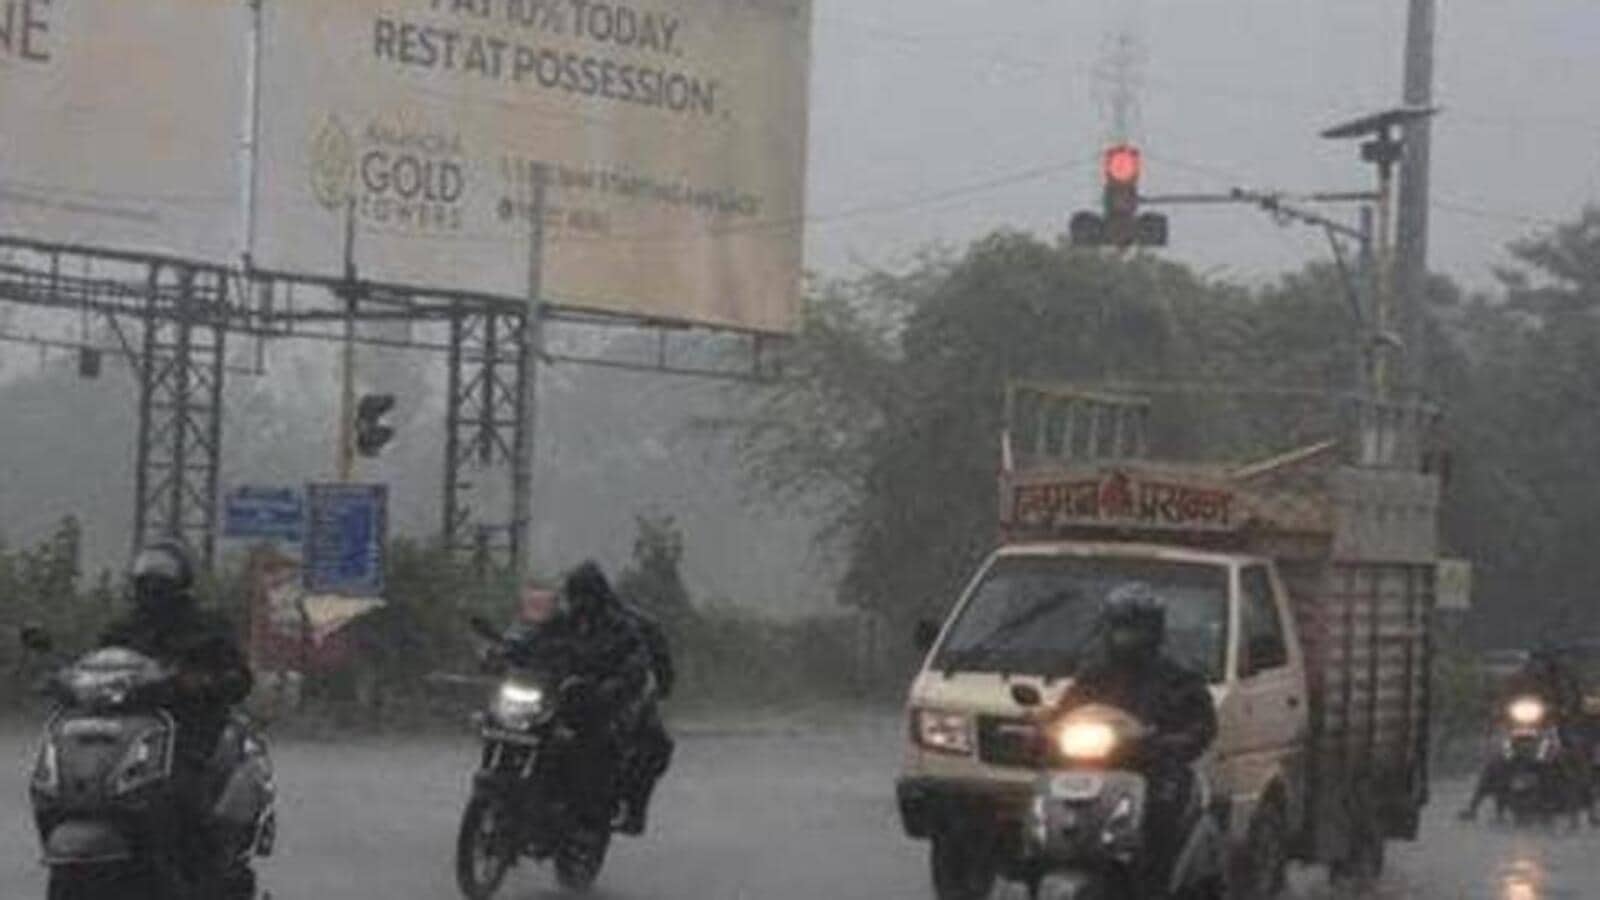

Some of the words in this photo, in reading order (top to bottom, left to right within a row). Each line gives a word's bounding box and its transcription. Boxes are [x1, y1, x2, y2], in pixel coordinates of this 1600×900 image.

[373, 19, 457, 68] REST
[464, 37, 508, 78] AT
[361, 151, 464, 204] GOLD
